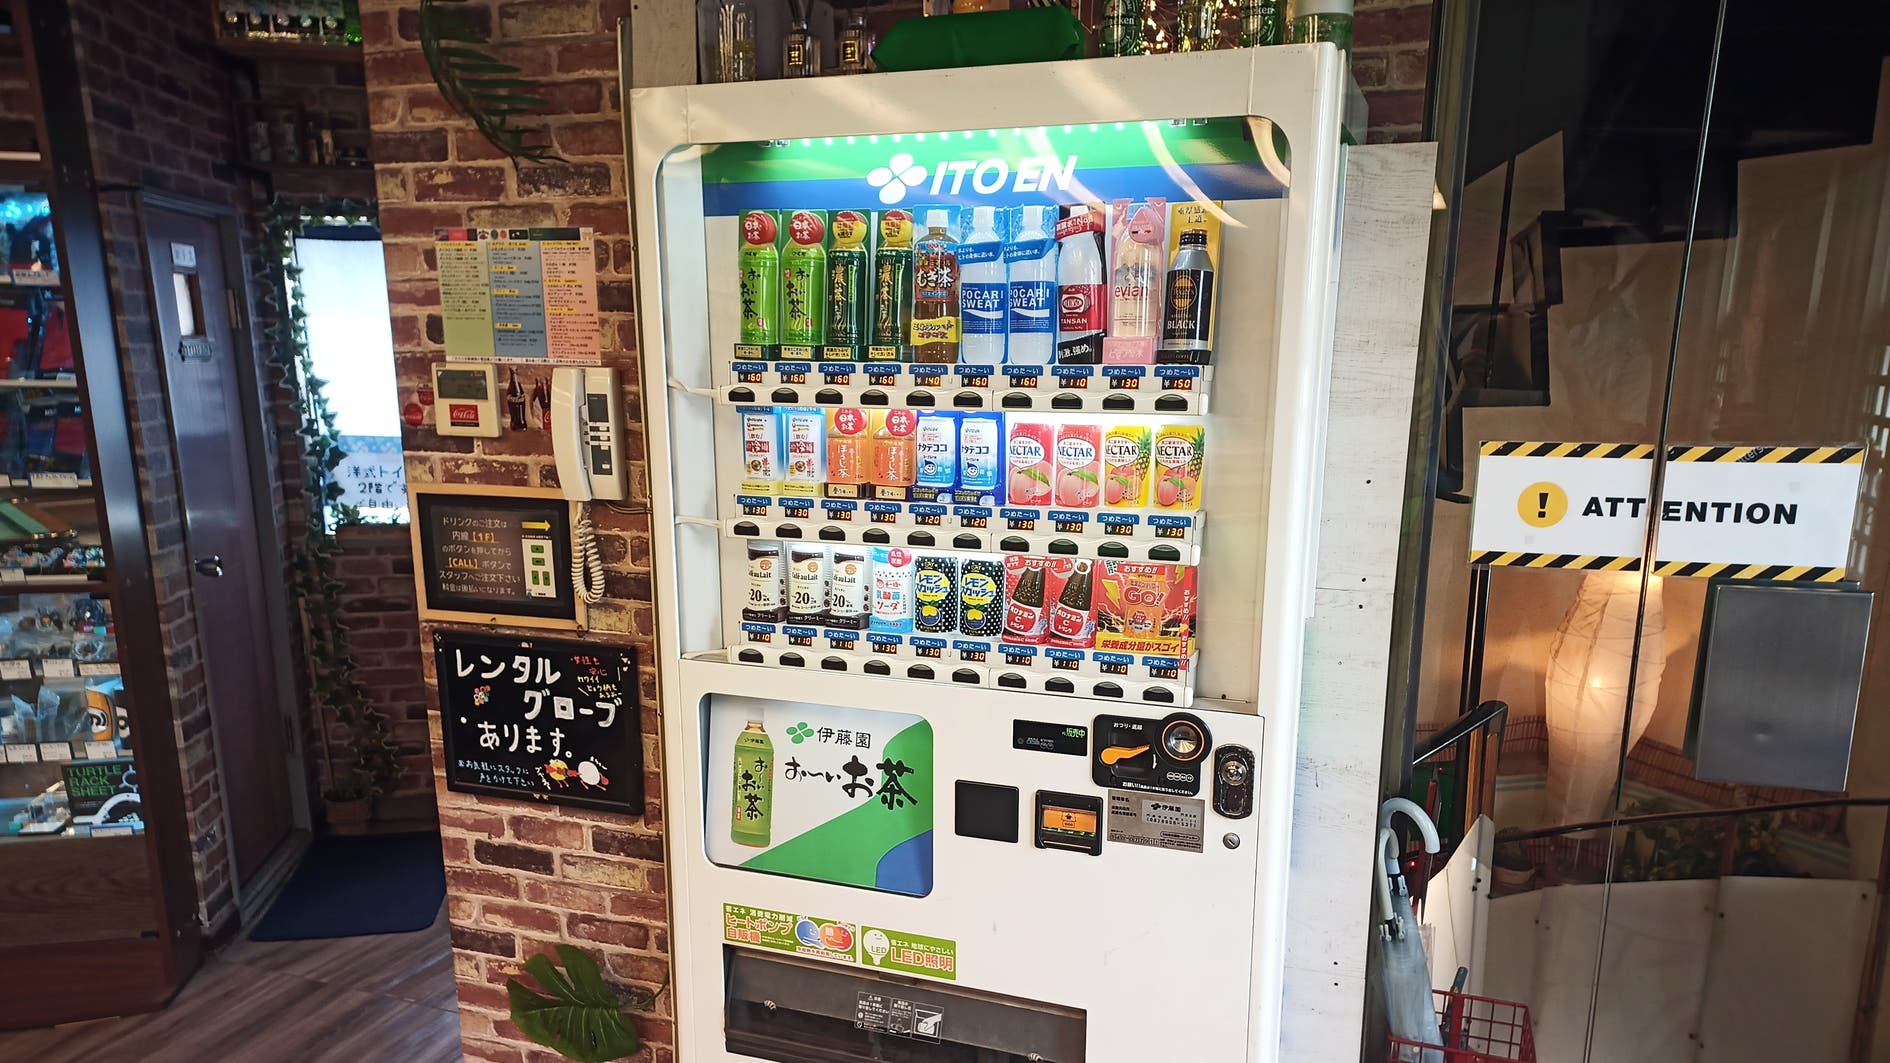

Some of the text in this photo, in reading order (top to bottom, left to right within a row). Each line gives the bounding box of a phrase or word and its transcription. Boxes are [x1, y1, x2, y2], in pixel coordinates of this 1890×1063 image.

[930, 155, 1078, 196] ITO EN
[916, 268, 955, 289] むぎ茶
[963, 290, 1004, 299] POCARI
[1115, 285, 1148, 297] evian
[963, 300, 1000, 309] SWEAT
[1168, 320, 1195, 330] BLACK
[838, 444, 849, 479] ほうじ茶
[887, 446, 898, 481] ほうじ茶
[442, 517, 508, 529] ドリンクのご注文は
[442, 544, 512, 557] のボタンを押してから
[439, 570, 521, 584] スタッフへご注文下さい
[919, 574, 943, 585] レモン
[965, 577, 989, 588] レモン
[750, 588, 762, 602] 20
[795, 592, 810, 605] 20
[833, 593, 845, 607] 20
[1101, 640, 1180, 653] 栄養成分量がスゴイ
[456, 648, 561, 685] レンタル
[523, 688, 623, 728] グローブ
[477, 721, 572, 759] あります。
[817, 727, 871, 749] 伊藤園
[69, 765, 121, 777] TURTLE
[70, 776, 110, 786] RACK
[71, 786, 116, 797] SHEET
[741, 770, 762, 820] お茶
[725, 905, 746, 916] 省エネ
[726, 913, 793, 937] ヒートポンプ
[726, 927, 761, 944] 自販機
[872, 945, 887, 955] LED
[891, 939, 909, 950] 省エネ
[891, 949, 953, 973] LED照明
